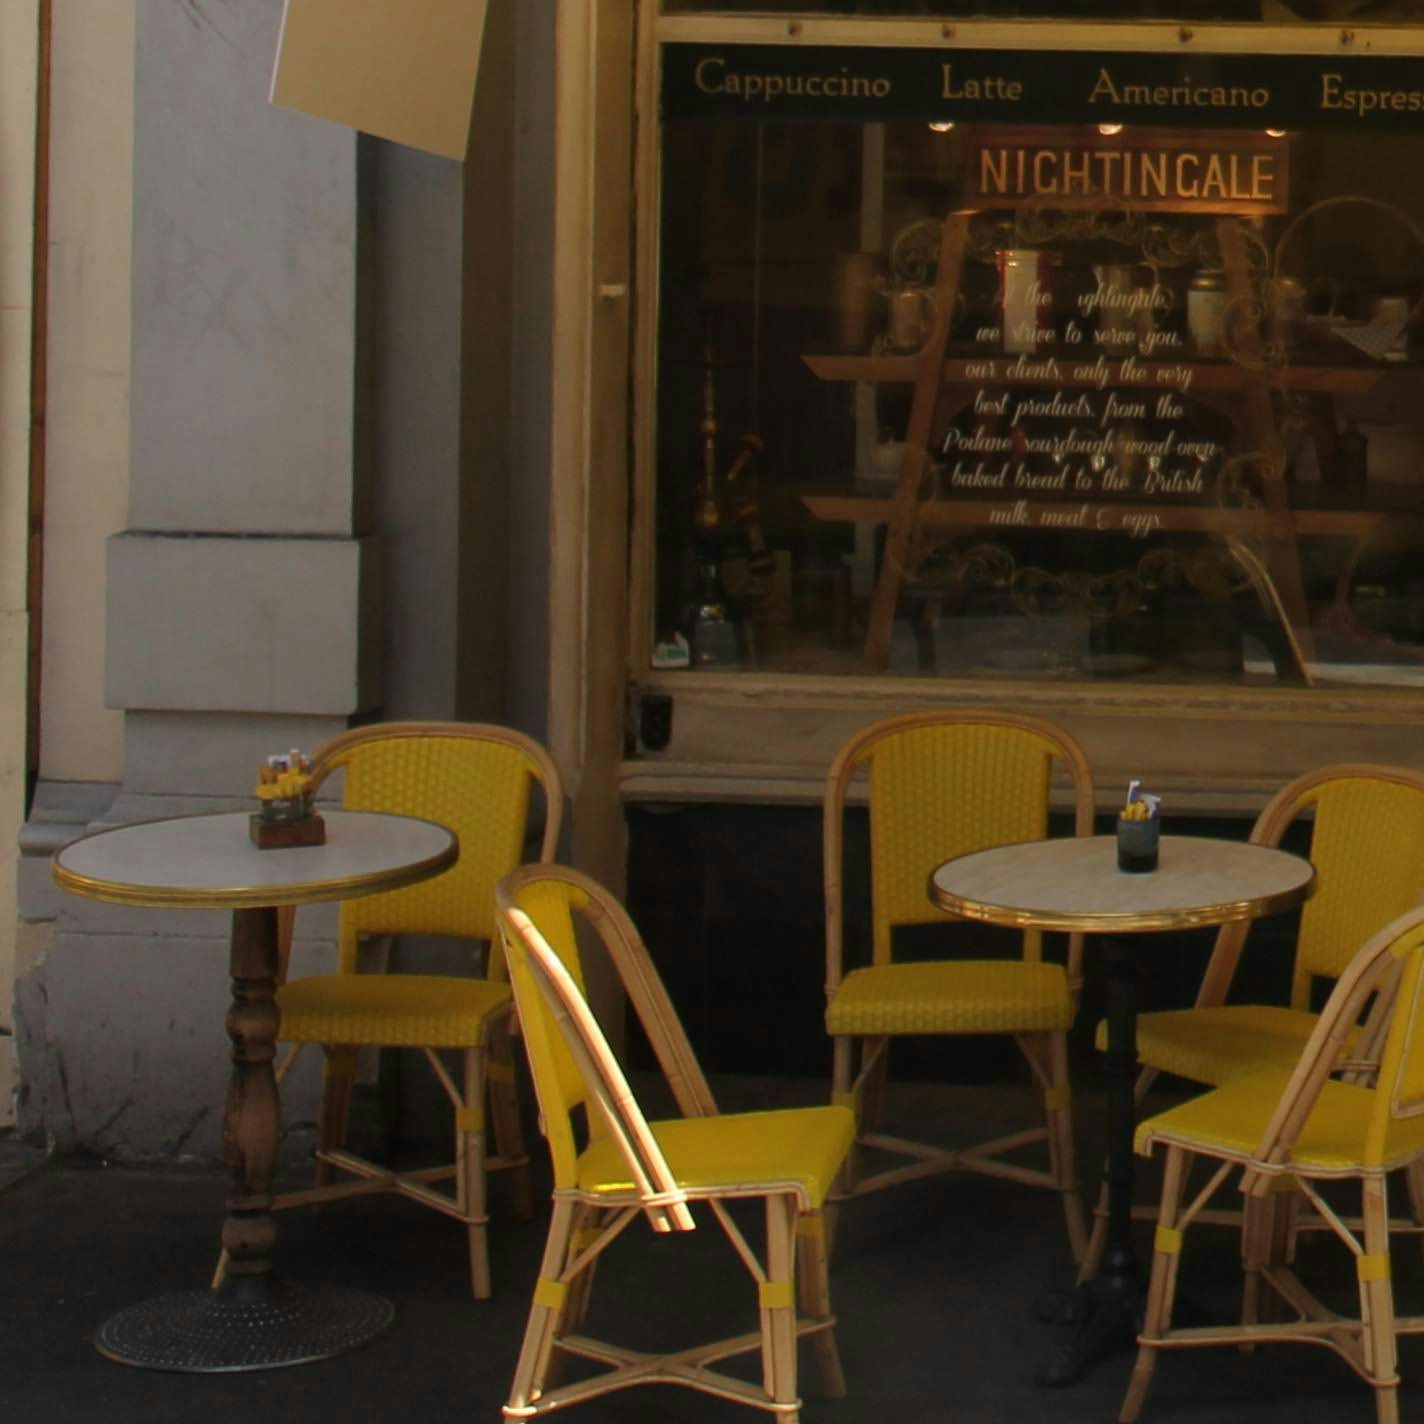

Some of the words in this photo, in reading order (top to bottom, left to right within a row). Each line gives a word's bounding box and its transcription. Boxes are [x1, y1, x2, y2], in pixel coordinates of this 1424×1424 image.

[693, 56, 892, 103] Cappuccino
[939, 63, 1024, 103] Latte
[1088, 68, 1270, 108] Americano
[978, 146, 1275, 203] NIGHTINGALE
[976, 328, 1000, 343] we
[1065, 322, 1082, 344] to
[965, 362, 995, 377] our
[1074, 357, 1110, 388] only
[1119, 356, 1146, 382] the
[974, 389, 1009, 415] best
[1102, 392, 1146, 426] from
[1156, 394, 1184, 419] the
[951, 462, 1009, 488] baked
[1014, 463, 1069, 489] bread
[1075, 467, 1092, 490] to
[1102, 465, 1130, 491] the
